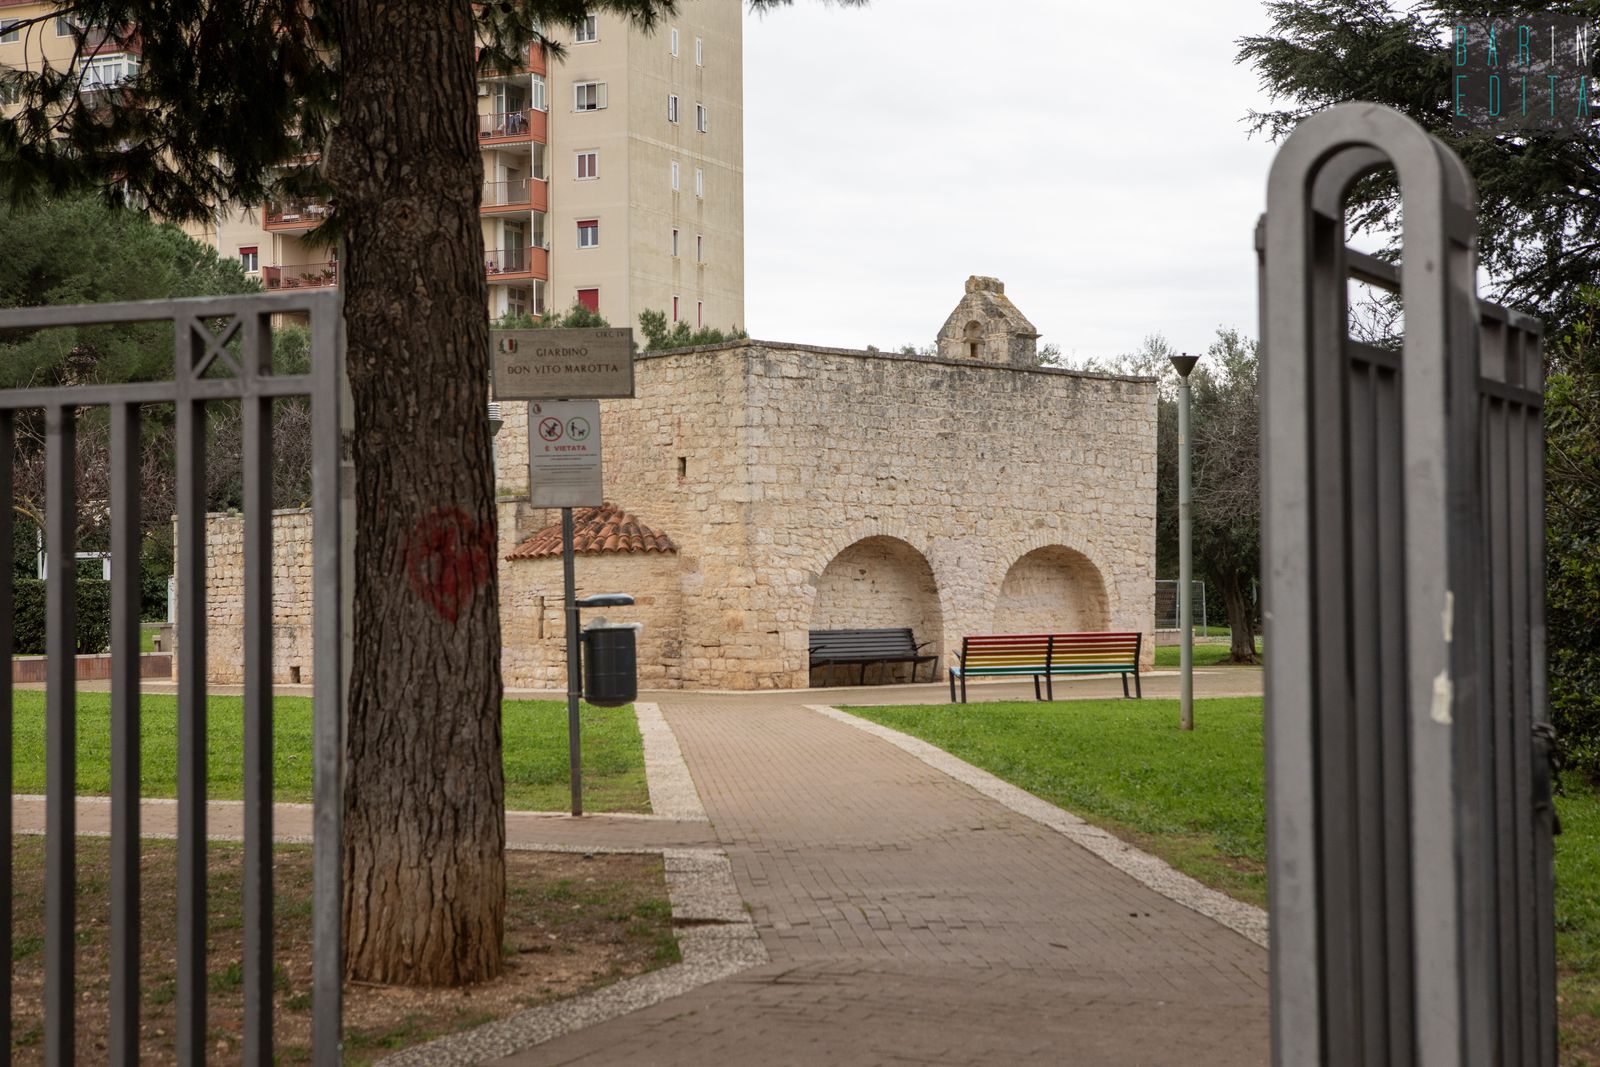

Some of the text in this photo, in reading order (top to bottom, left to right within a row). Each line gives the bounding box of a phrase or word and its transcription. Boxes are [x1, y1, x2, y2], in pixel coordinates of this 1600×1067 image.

[536, 347, 588, 357] GIARDINO
[507, 363, 619, 375] DON VITO MAROTTA
